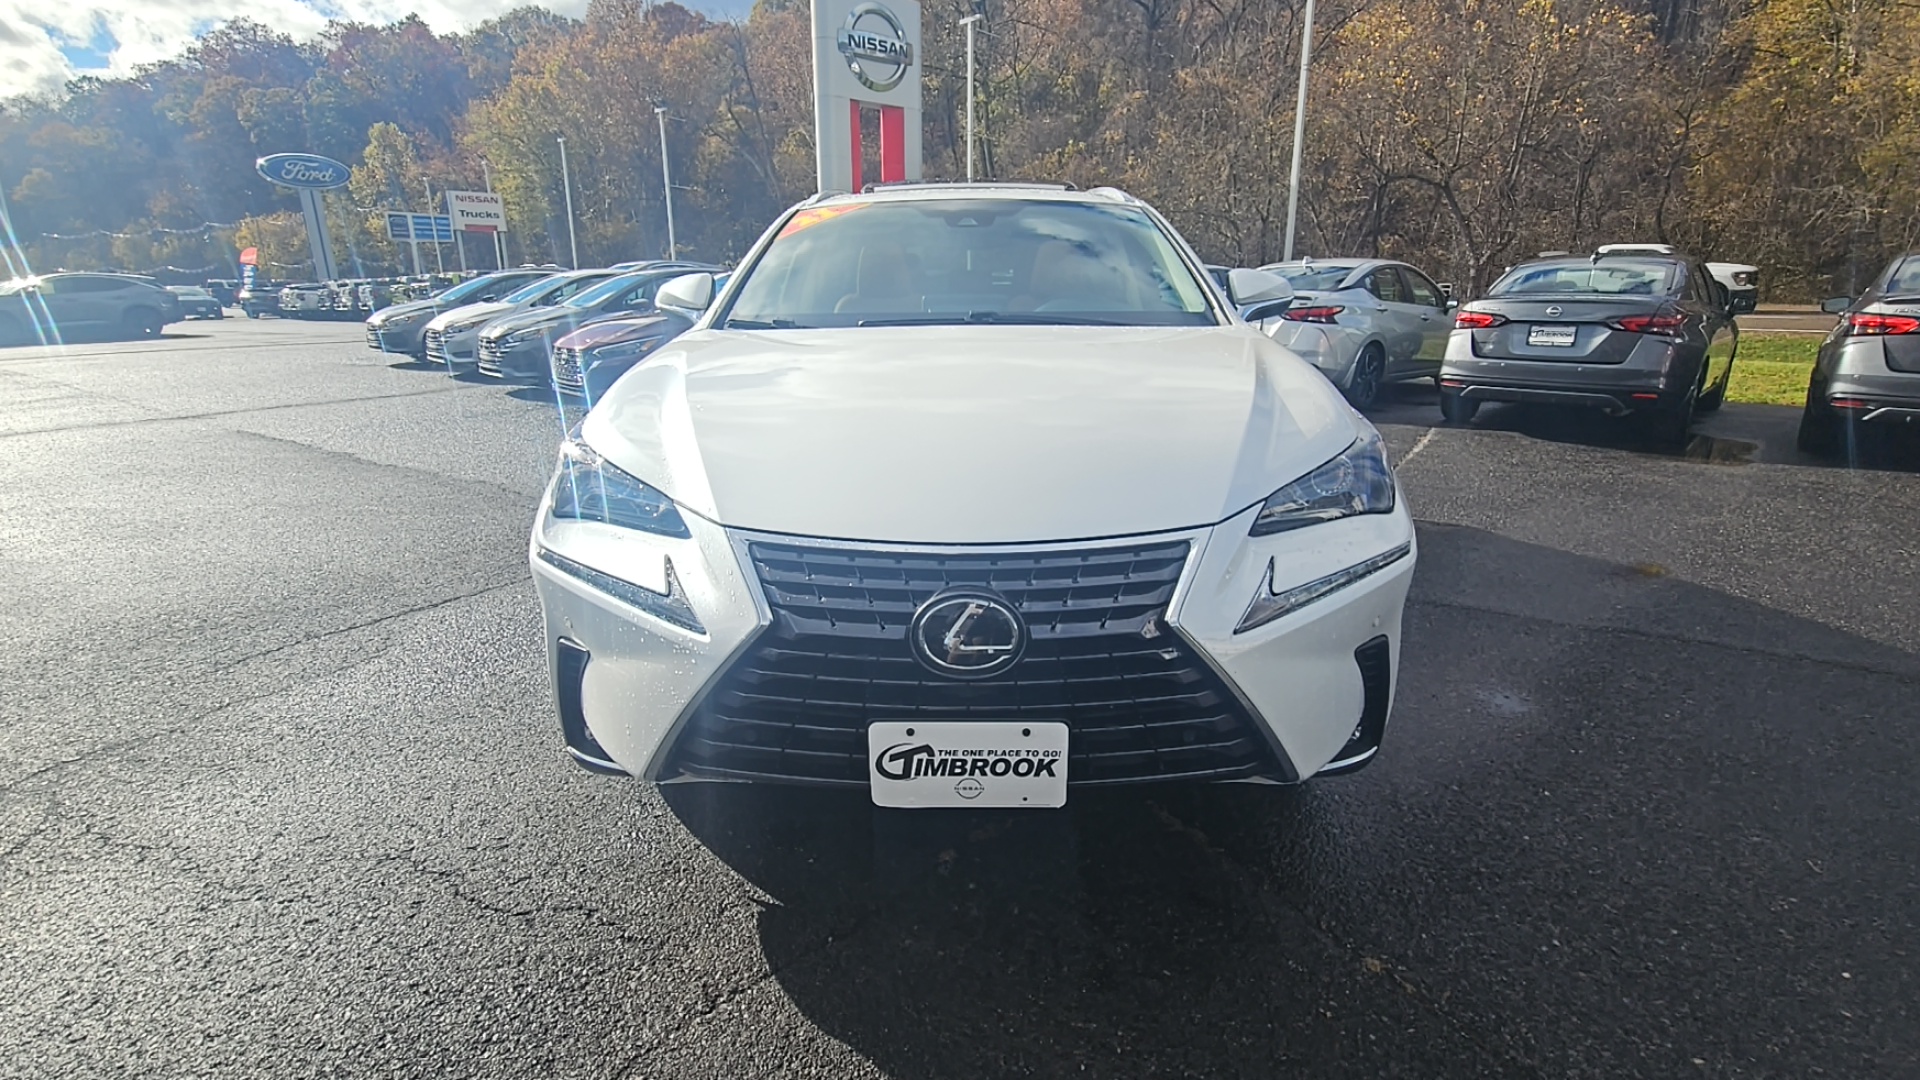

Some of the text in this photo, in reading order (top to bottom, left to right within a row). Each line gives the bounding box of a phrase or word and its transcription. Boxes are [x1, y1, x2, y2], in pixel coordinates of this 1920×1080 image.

[848, 33, 908, 59] NISSAN
[281, 160, 336, 182] Ford
[455, 194, 499, 205] NISSAN
[458, 209, 500, 220] Trucks
[875, 743, 1060, 780] TIMBROOK
[938, 749, 1062, 758] THE ONE PLACE TO GO!
